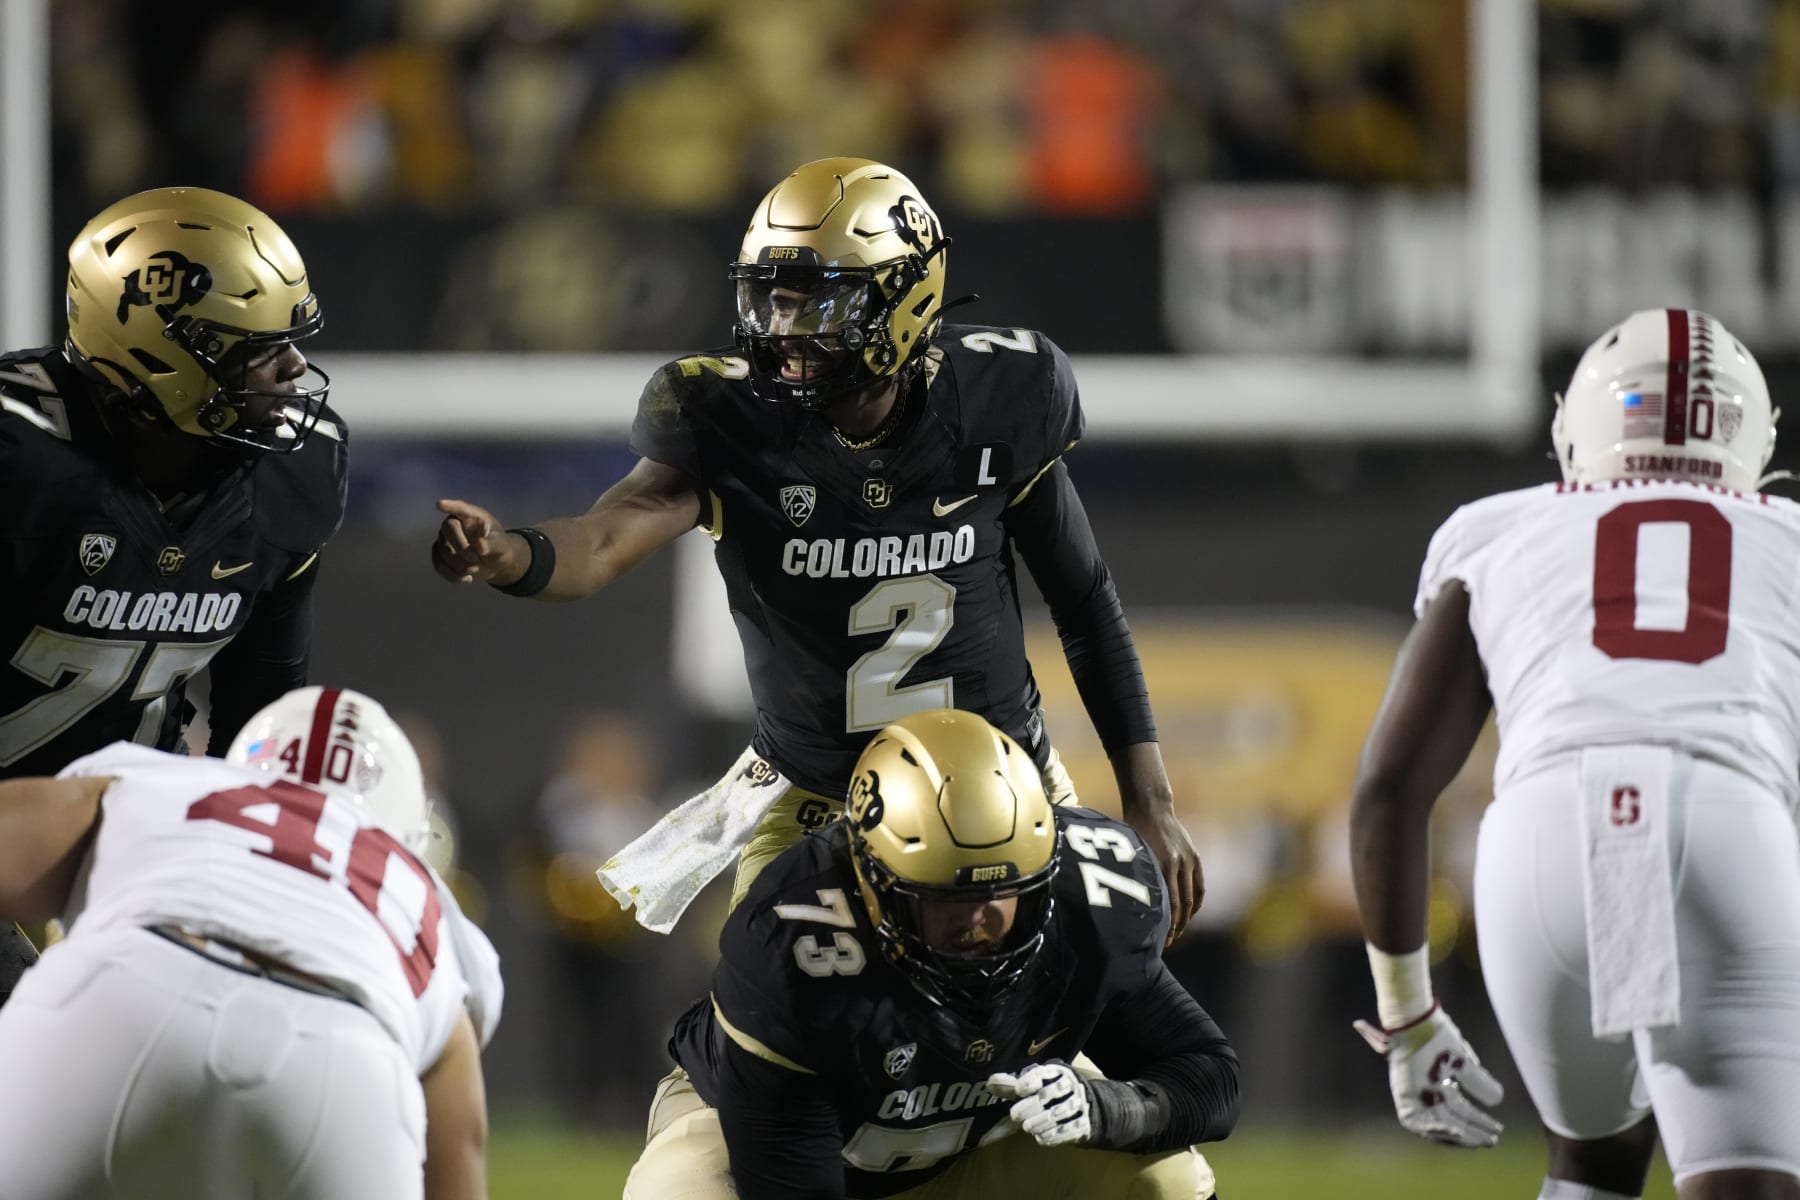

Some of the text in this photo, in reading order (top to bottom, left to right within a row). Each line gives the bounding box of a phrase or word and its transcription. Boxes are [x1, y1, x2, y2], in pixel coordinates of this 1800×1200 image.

[768, 247, 799, 260] BUFFS
[961, 329, 1038, 354] 2
[676, 355, 750, 380] 2
[1690, 399, 1714, 441] 0
[977, 448, 997, 485] L
[1624, 454, 1723, 479] STANFORD
[790, 501, 808, 518] 12
[85, 551, 104, 568] 12
[782, 523, 975, 578] COLORADO
[1592, 498, 1733, 665] 0
[63, 584, 242, 633] COLORADO
[846, 573, 957, 734] 2
[972, 865, 1007, 881] BUFFS
[1064, 823, 1151, 909] 73
[186, 778, 443, 1000] 40
[772, 887, 867, 977] 73
[877, 1080, 1003, 1121] COLOR
